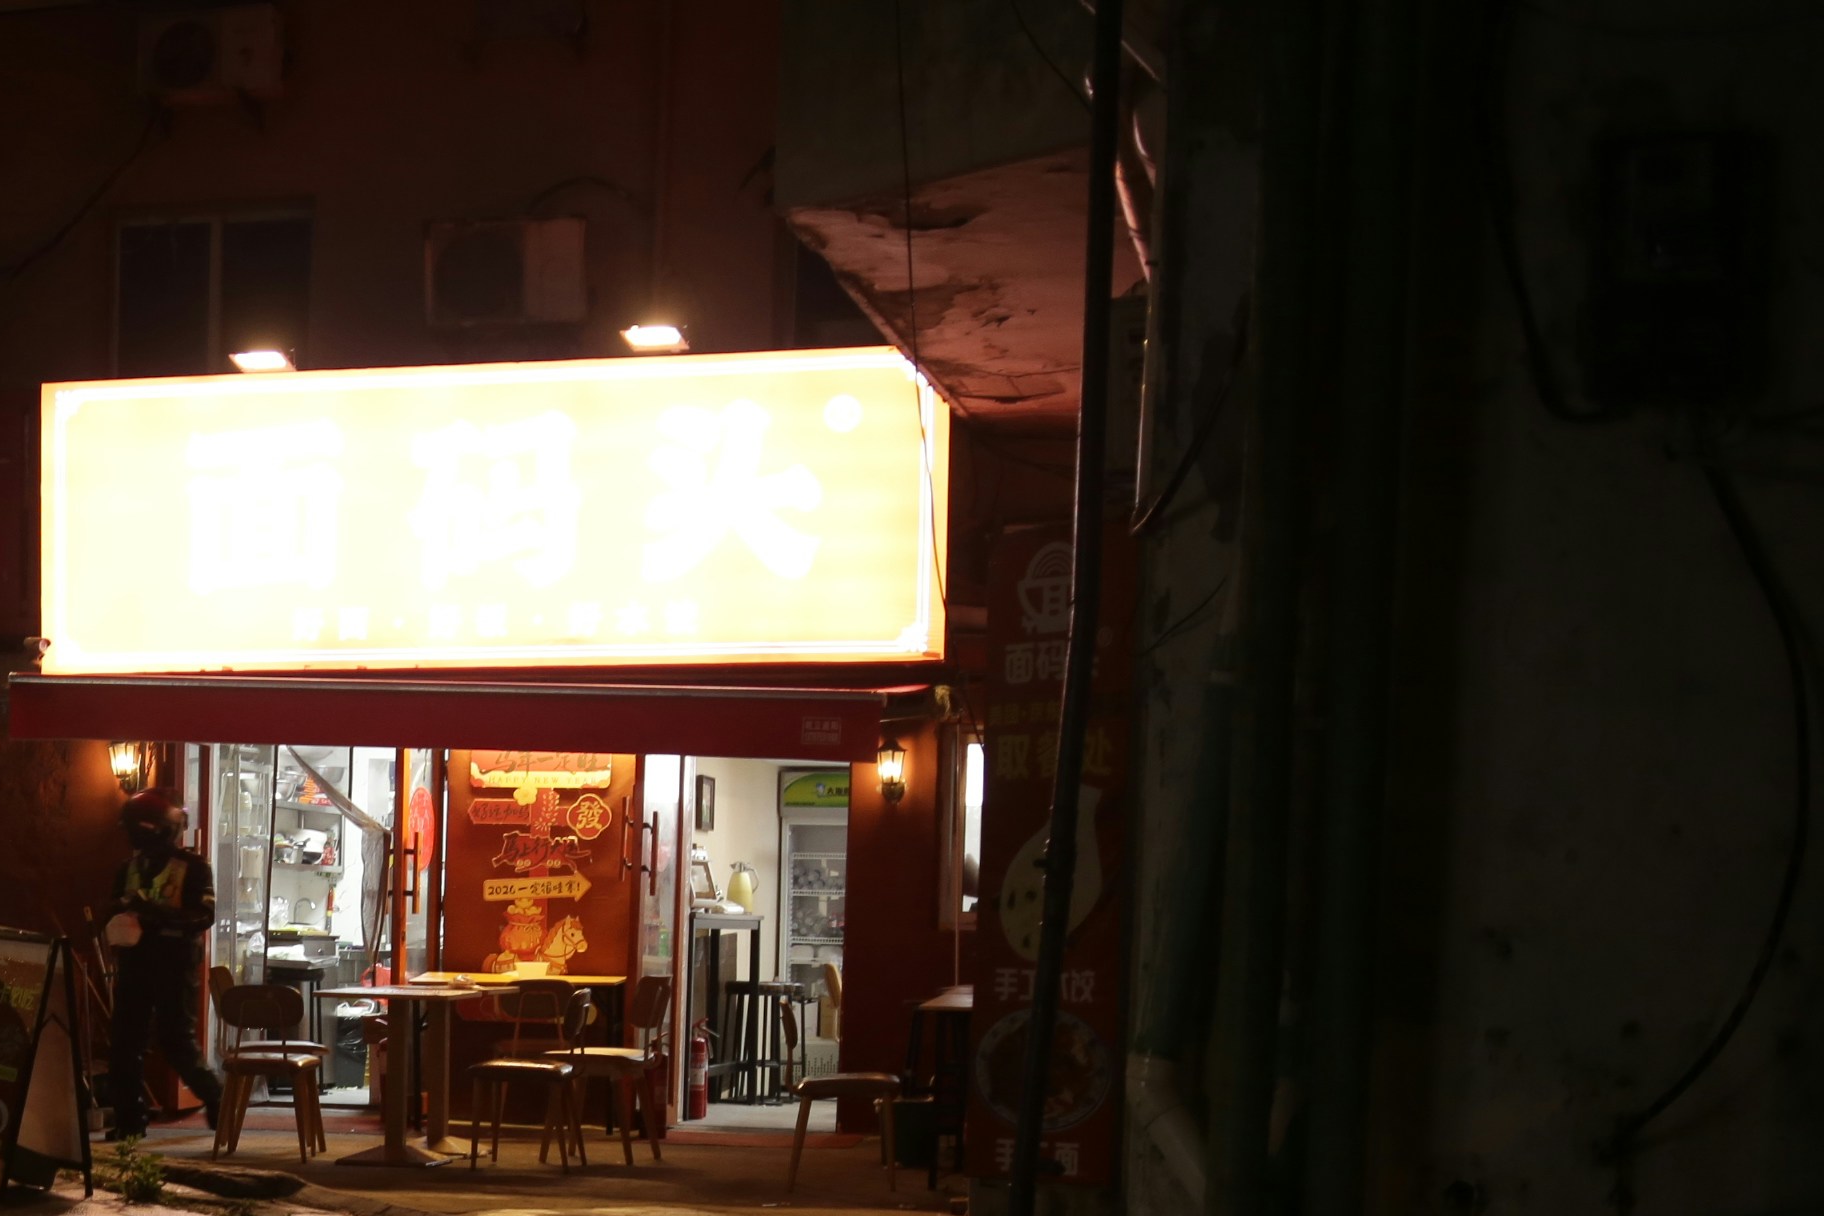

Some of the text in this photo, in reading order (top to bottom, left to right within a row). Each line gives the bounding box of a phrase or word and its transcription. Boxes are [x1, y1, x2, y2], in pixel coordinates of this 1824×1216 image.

[185, 397, 823, 593] 面码头
[1005, 640, 1099, 684] 面码
[488, 776, 597, 784] HAPPY NEW YEAR
[575, 800, 604, 831] 發
[995, 1138, 1080, 1177] 手面
